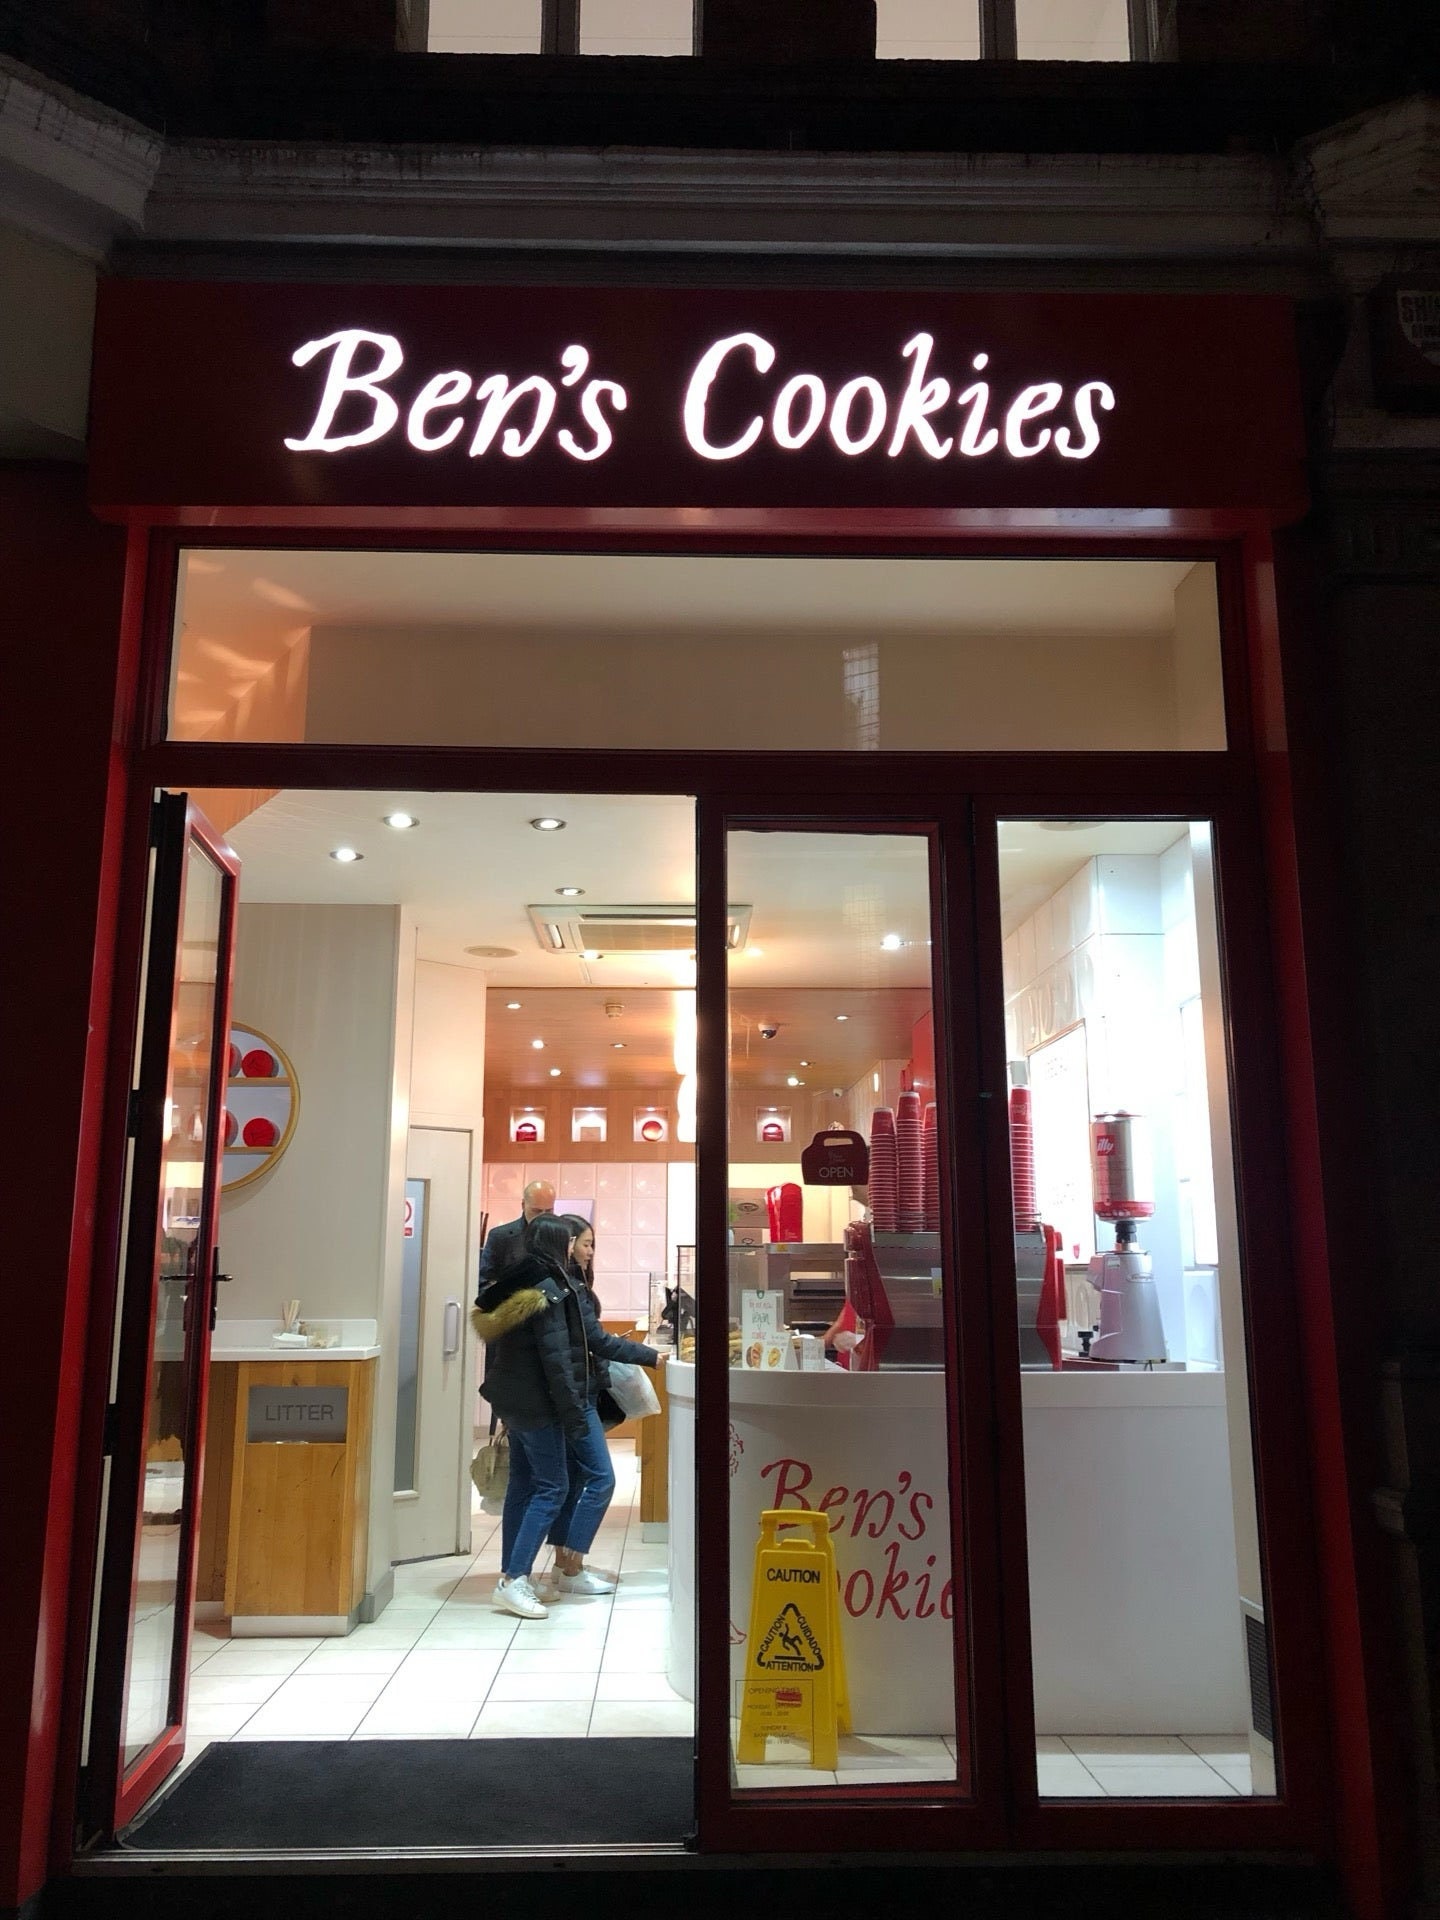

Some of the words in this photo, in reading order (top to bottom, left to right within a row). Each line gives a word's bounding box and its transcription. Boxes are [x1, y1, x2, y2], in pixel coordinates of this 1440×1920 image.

[284, 329, 627, 460] Ben's
[684, 333, 1115, 460] Cookies
[1097, 1138, 1114, 1154] illy
[819, 1166, 854, 1178] OPEN
[265, 1404, 335, 1421] LITTER
[759, 1459, 933, 1540] Ben's
[766, 1568, 821, 1584] CAUTION
[760, 1615, 786, 1653] CAUTION
[797, 1615, 821, 1656] CUIDADO
[766, 1661, 814, 1673] ATTENTION
